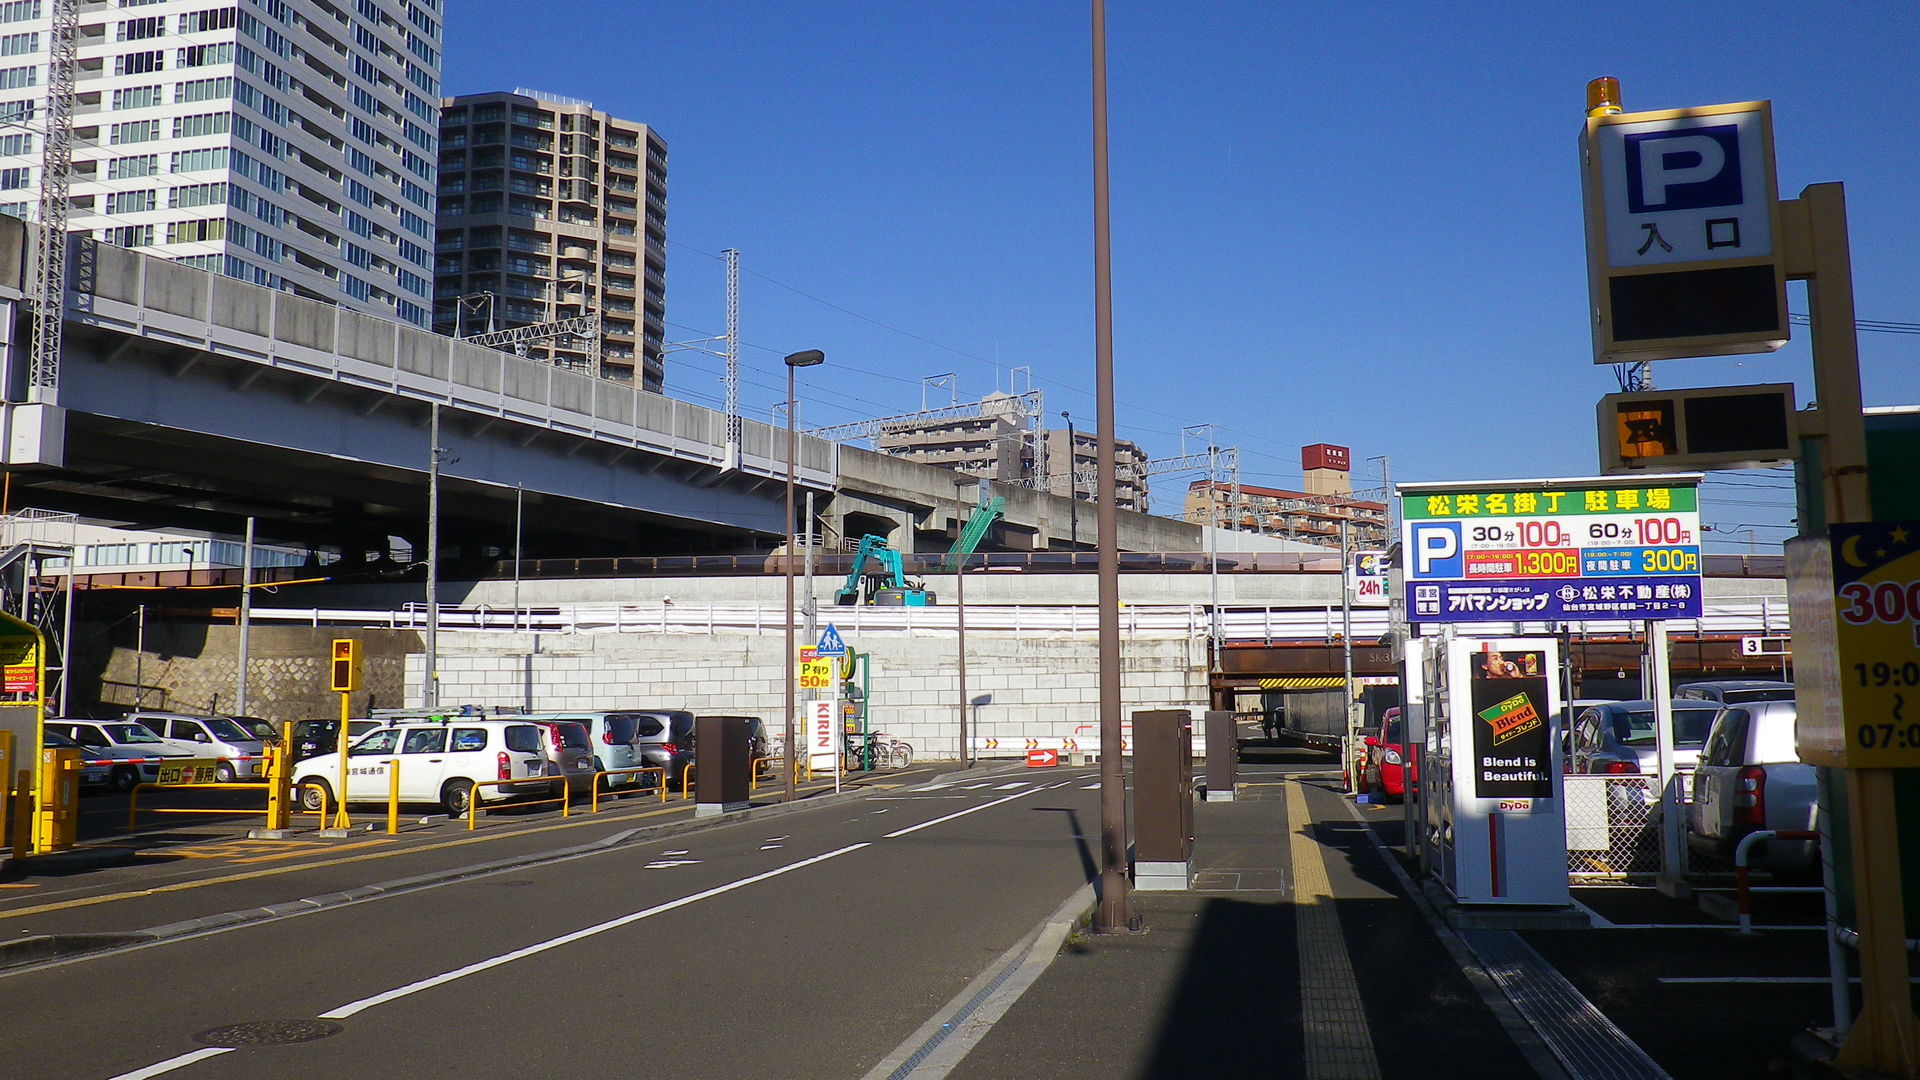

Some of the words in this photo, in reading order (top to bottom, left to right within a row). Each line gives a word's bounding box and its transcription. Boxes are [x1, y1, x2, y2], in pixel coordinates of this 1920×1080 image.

[1639, 135, 1725, 206] P
[1636, 217, 1741, 256] 入口
[1427, 492, 1565, 516] 松栄名掛丁
[1584, 488, 1671, 512] 駐車場
[1472, 526, 1515, 542] 30分
[1516, 521, 1570, 547] 100円
[1589, 523, 1632, 539] 60分
[1634, 517, 1691, 545] 100円
[1417, 527, 1458, 574] P
[1586, 559, 1631, 572] 夜間駐車
[1642, 548, 1697, 572] 300円
[1515, 551, 1578, 575] 1,300円
[1358, 580, 1380, 596] 24h
[1448, 593, 1549, 611] アパマンショップ
[1747, 640, 1757, 653] 3
[1501, 699, 1525, 712] DyDo
[818, 703, 829, 747] KIRIN
[1495, 706, 1533, 730] Blend
[1483, 757, 1521, 767] Blend
[1524, 757, 1536, 767] is
[160, 768, 181, 782] 出口
[1483, 771, 1548, 781] Beautiful.
[1500, 802, 1529, 811] DyDo
